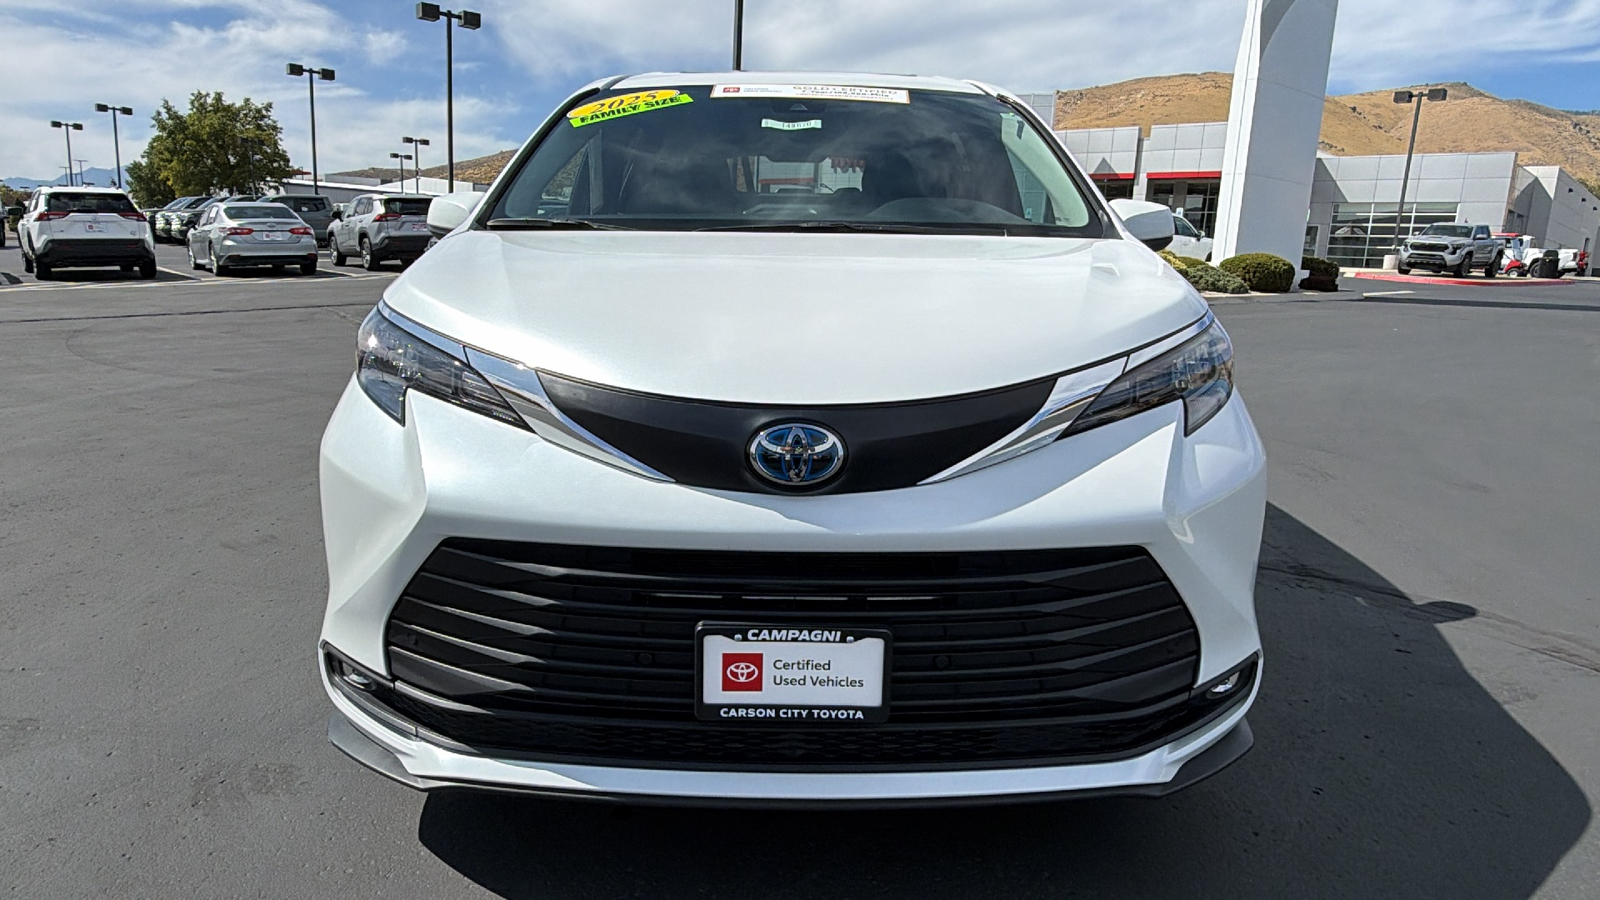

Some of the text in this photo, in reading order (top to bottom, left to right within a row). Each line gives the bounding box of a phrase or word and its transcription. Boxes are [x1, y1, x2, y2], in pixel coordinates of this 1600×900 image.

[832, 87, 898, 95] CERTIFIED
[590, 91, 659, 114] 2025
[580, 96, 683, 123] FAMILY SIZE
[747, 629, 841, 642] CAMPAGNI
[772, 659, 831, 671] Certified
[772, 675, 864, 688] Used Vehicles
[719, 707, 864, 720] CARSON CITY TOYOTA
